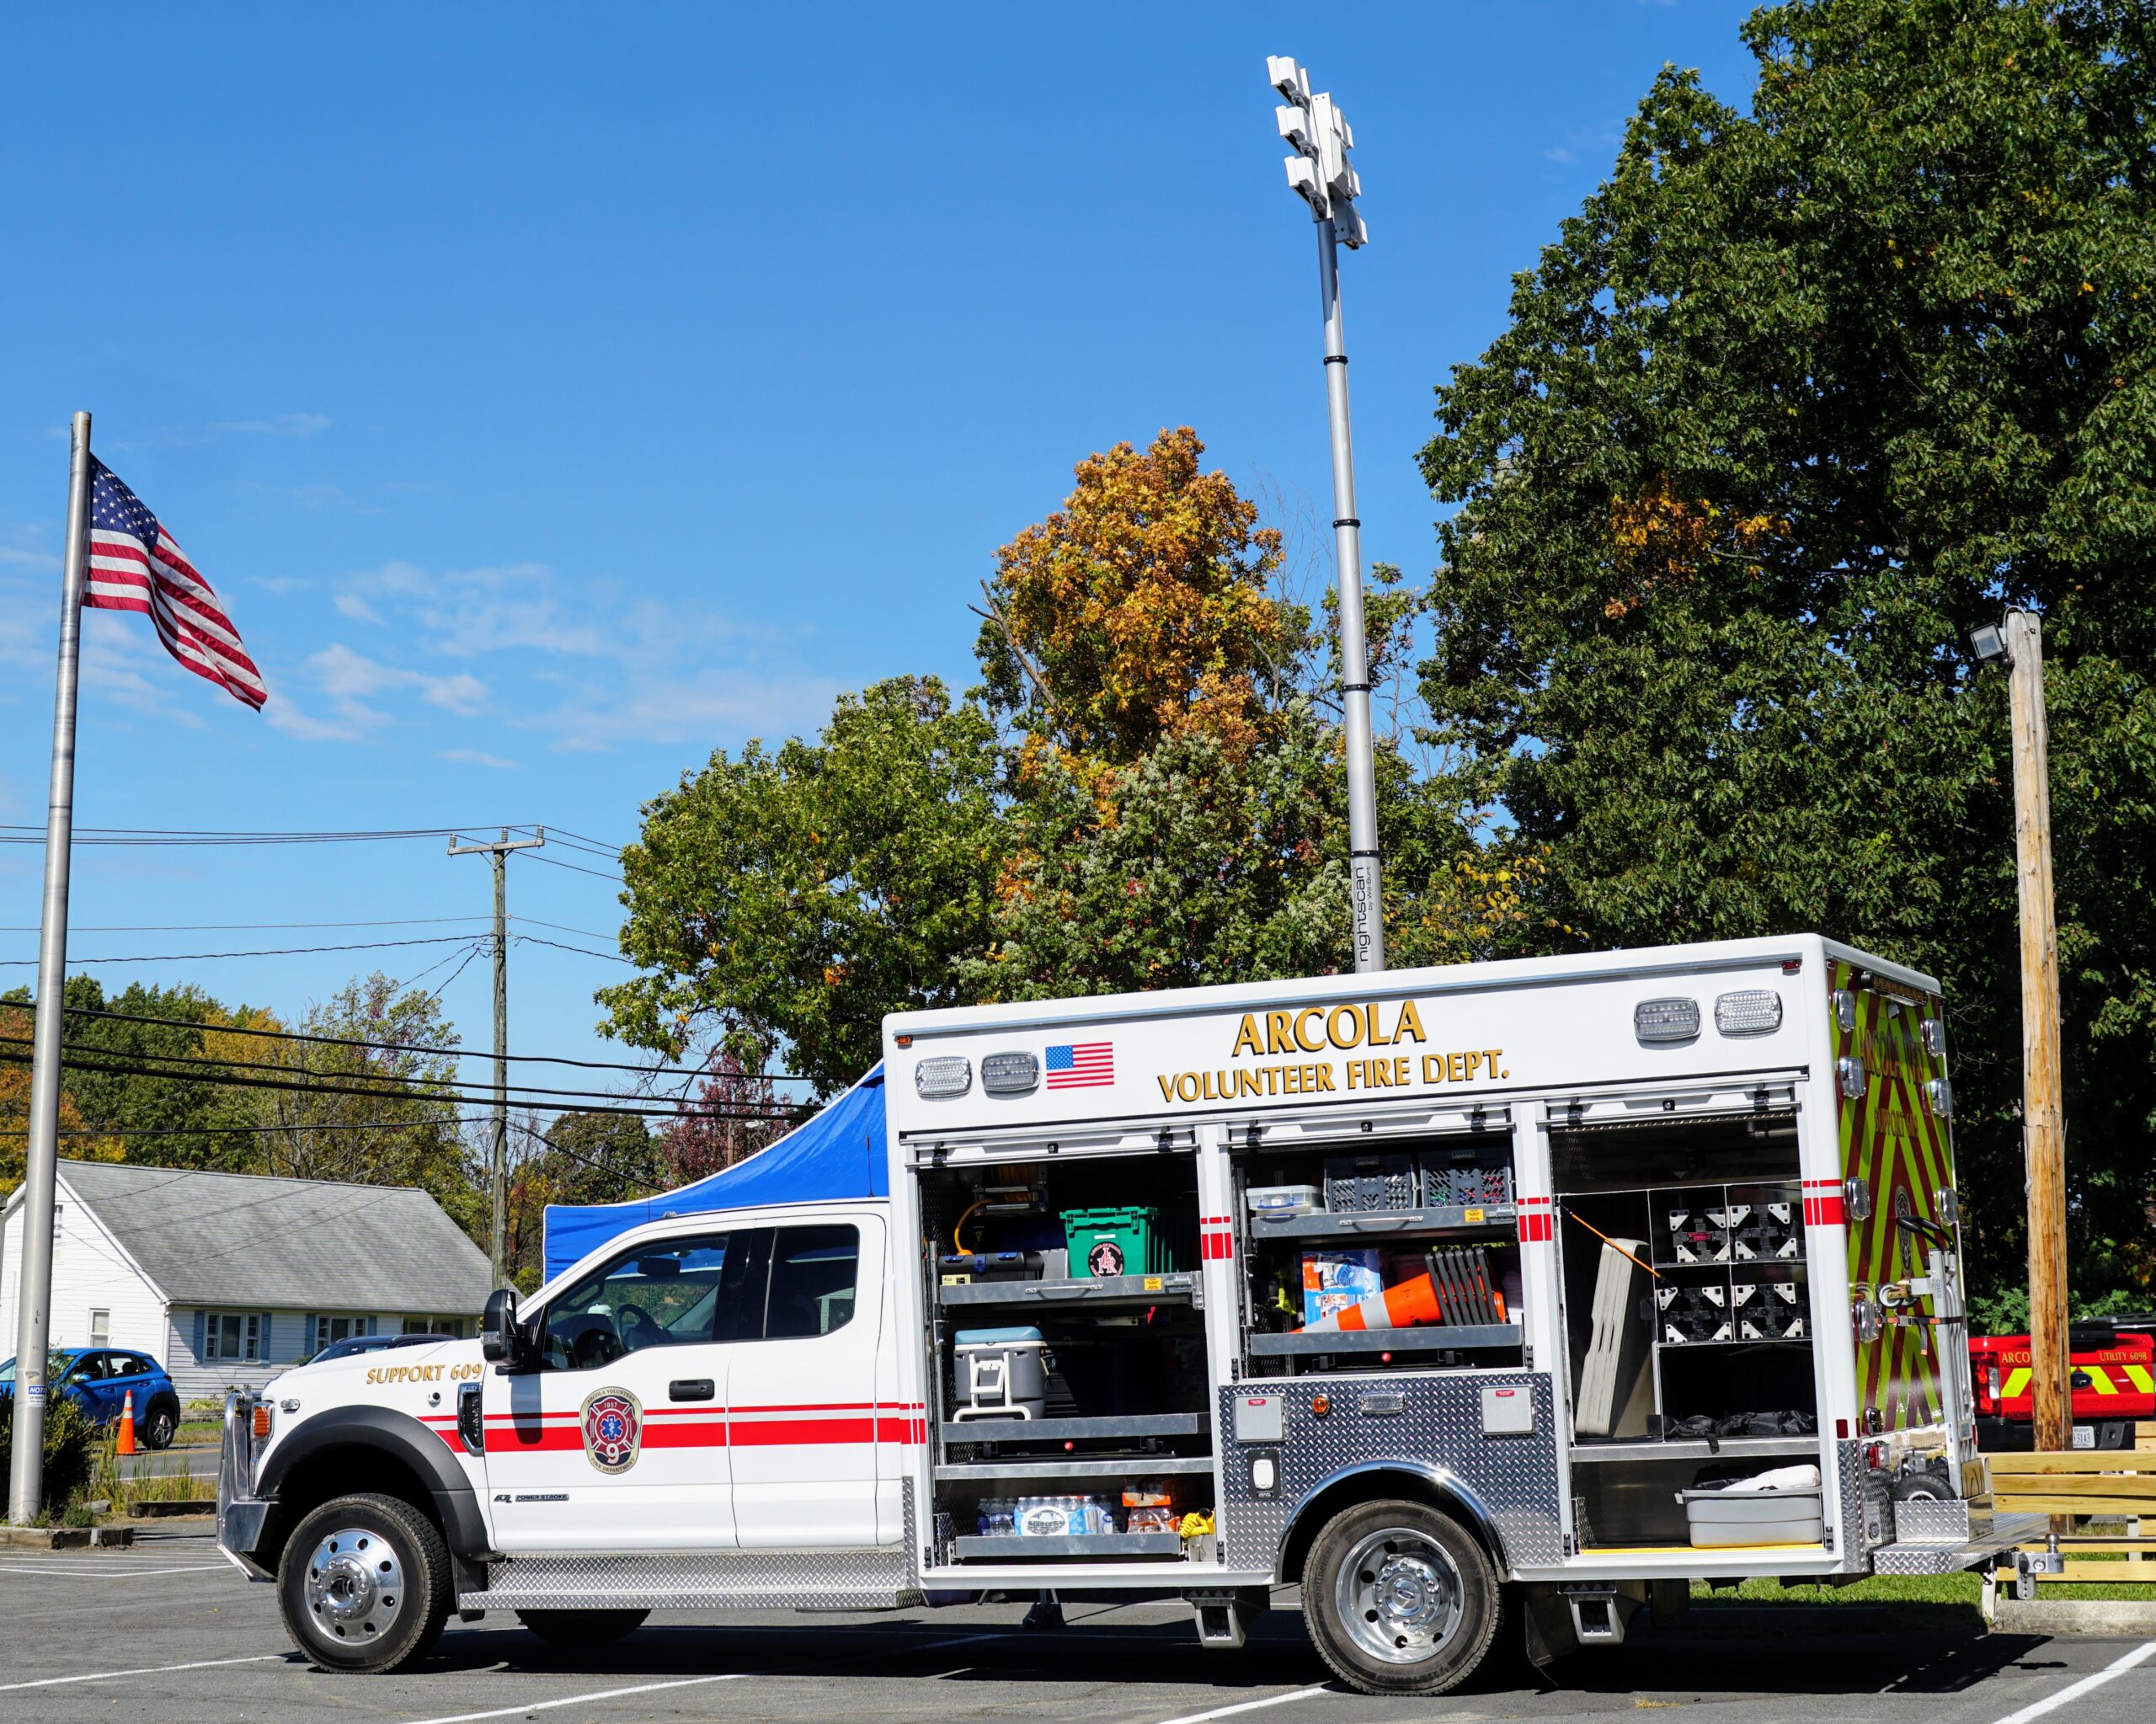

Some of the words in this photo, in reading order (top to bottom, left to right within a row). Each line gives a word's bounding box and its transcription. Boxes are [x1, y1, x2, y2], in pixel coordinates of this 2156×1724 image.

[1356, 867, 1370, 962] nightscan
[1368, 901, 1373, 910] by
[1232, 1000, 1427, 1057] ARCOLA
[1859, 1026, 1903, 1079] ARCOLA
[1903, 1037, 1925, 1085] VFD
[1158, 1061, 1336, 1102] VOLUNTEER
[1348, 1056, 1411, 1089] FIRE
[1422, 1049, 1510, 1083] DEPT.
[1875, 1108, 1905, 1137] SUPPORT
[2001, 1352, 2032, 1364] ARCO
[2100, 1352, 2127, 1361] UTILITY
[366, 1364, 446, 1385] SUPPORT
[451, 1363, 483, 1381] 609
[587, 1390, 606, 1404] ARCOLA
[606, 1389, 636, 1402] VOLUNTEER
[606, 1443, 620, 1464] 9
[590, 1457, 601, 1469] FIRE
[602, 1457, 635, 1473] DEPARTMENT
